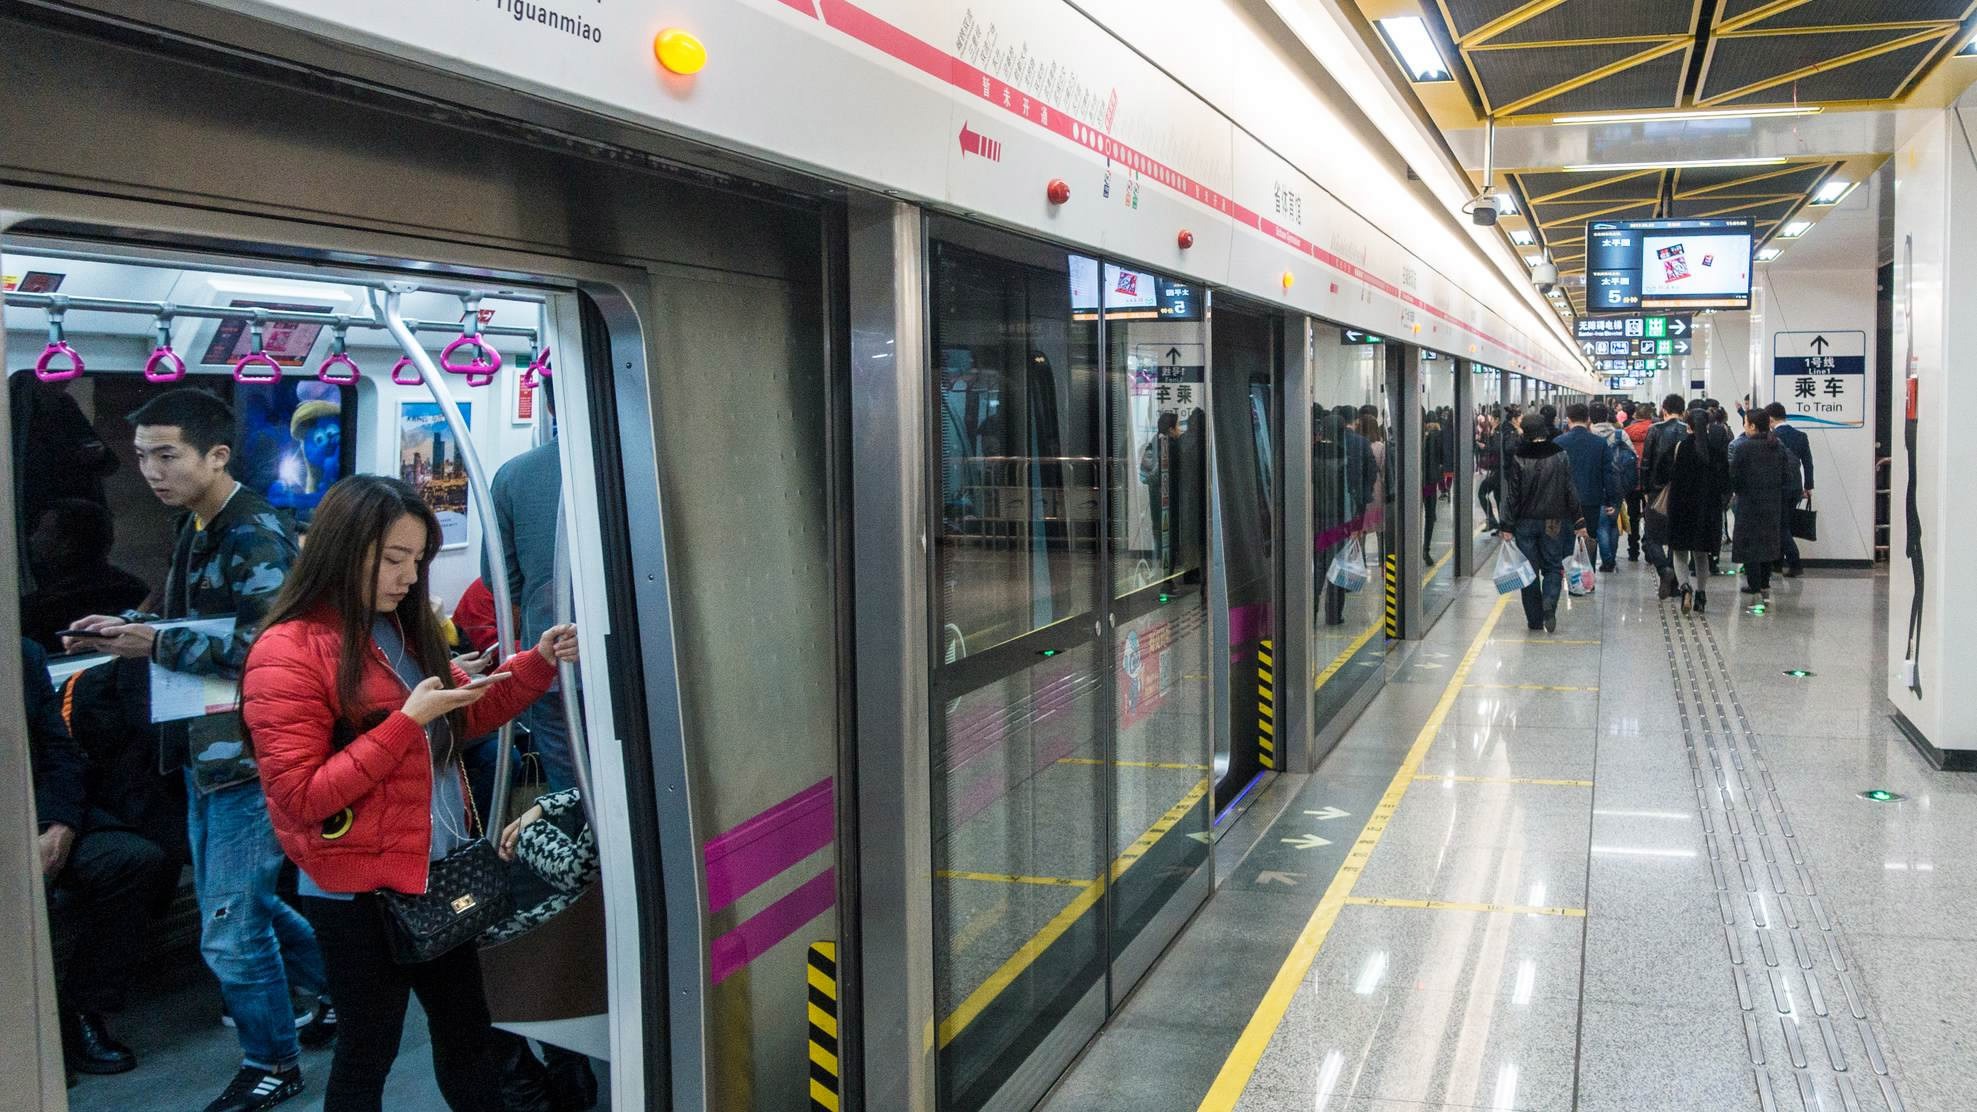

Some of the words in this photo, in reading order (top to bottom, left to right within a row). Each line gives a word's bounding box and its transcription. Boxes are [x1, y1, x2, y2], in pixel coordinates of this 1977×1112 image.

[1609, 290, 1621, 303] 5
[1805, 356, 1835, 368] 1号线
[1795, 377, 1844, 398] 乘车
[1796, 402, 1811, 412] To
[1813, 402, 1843, 412] Train
